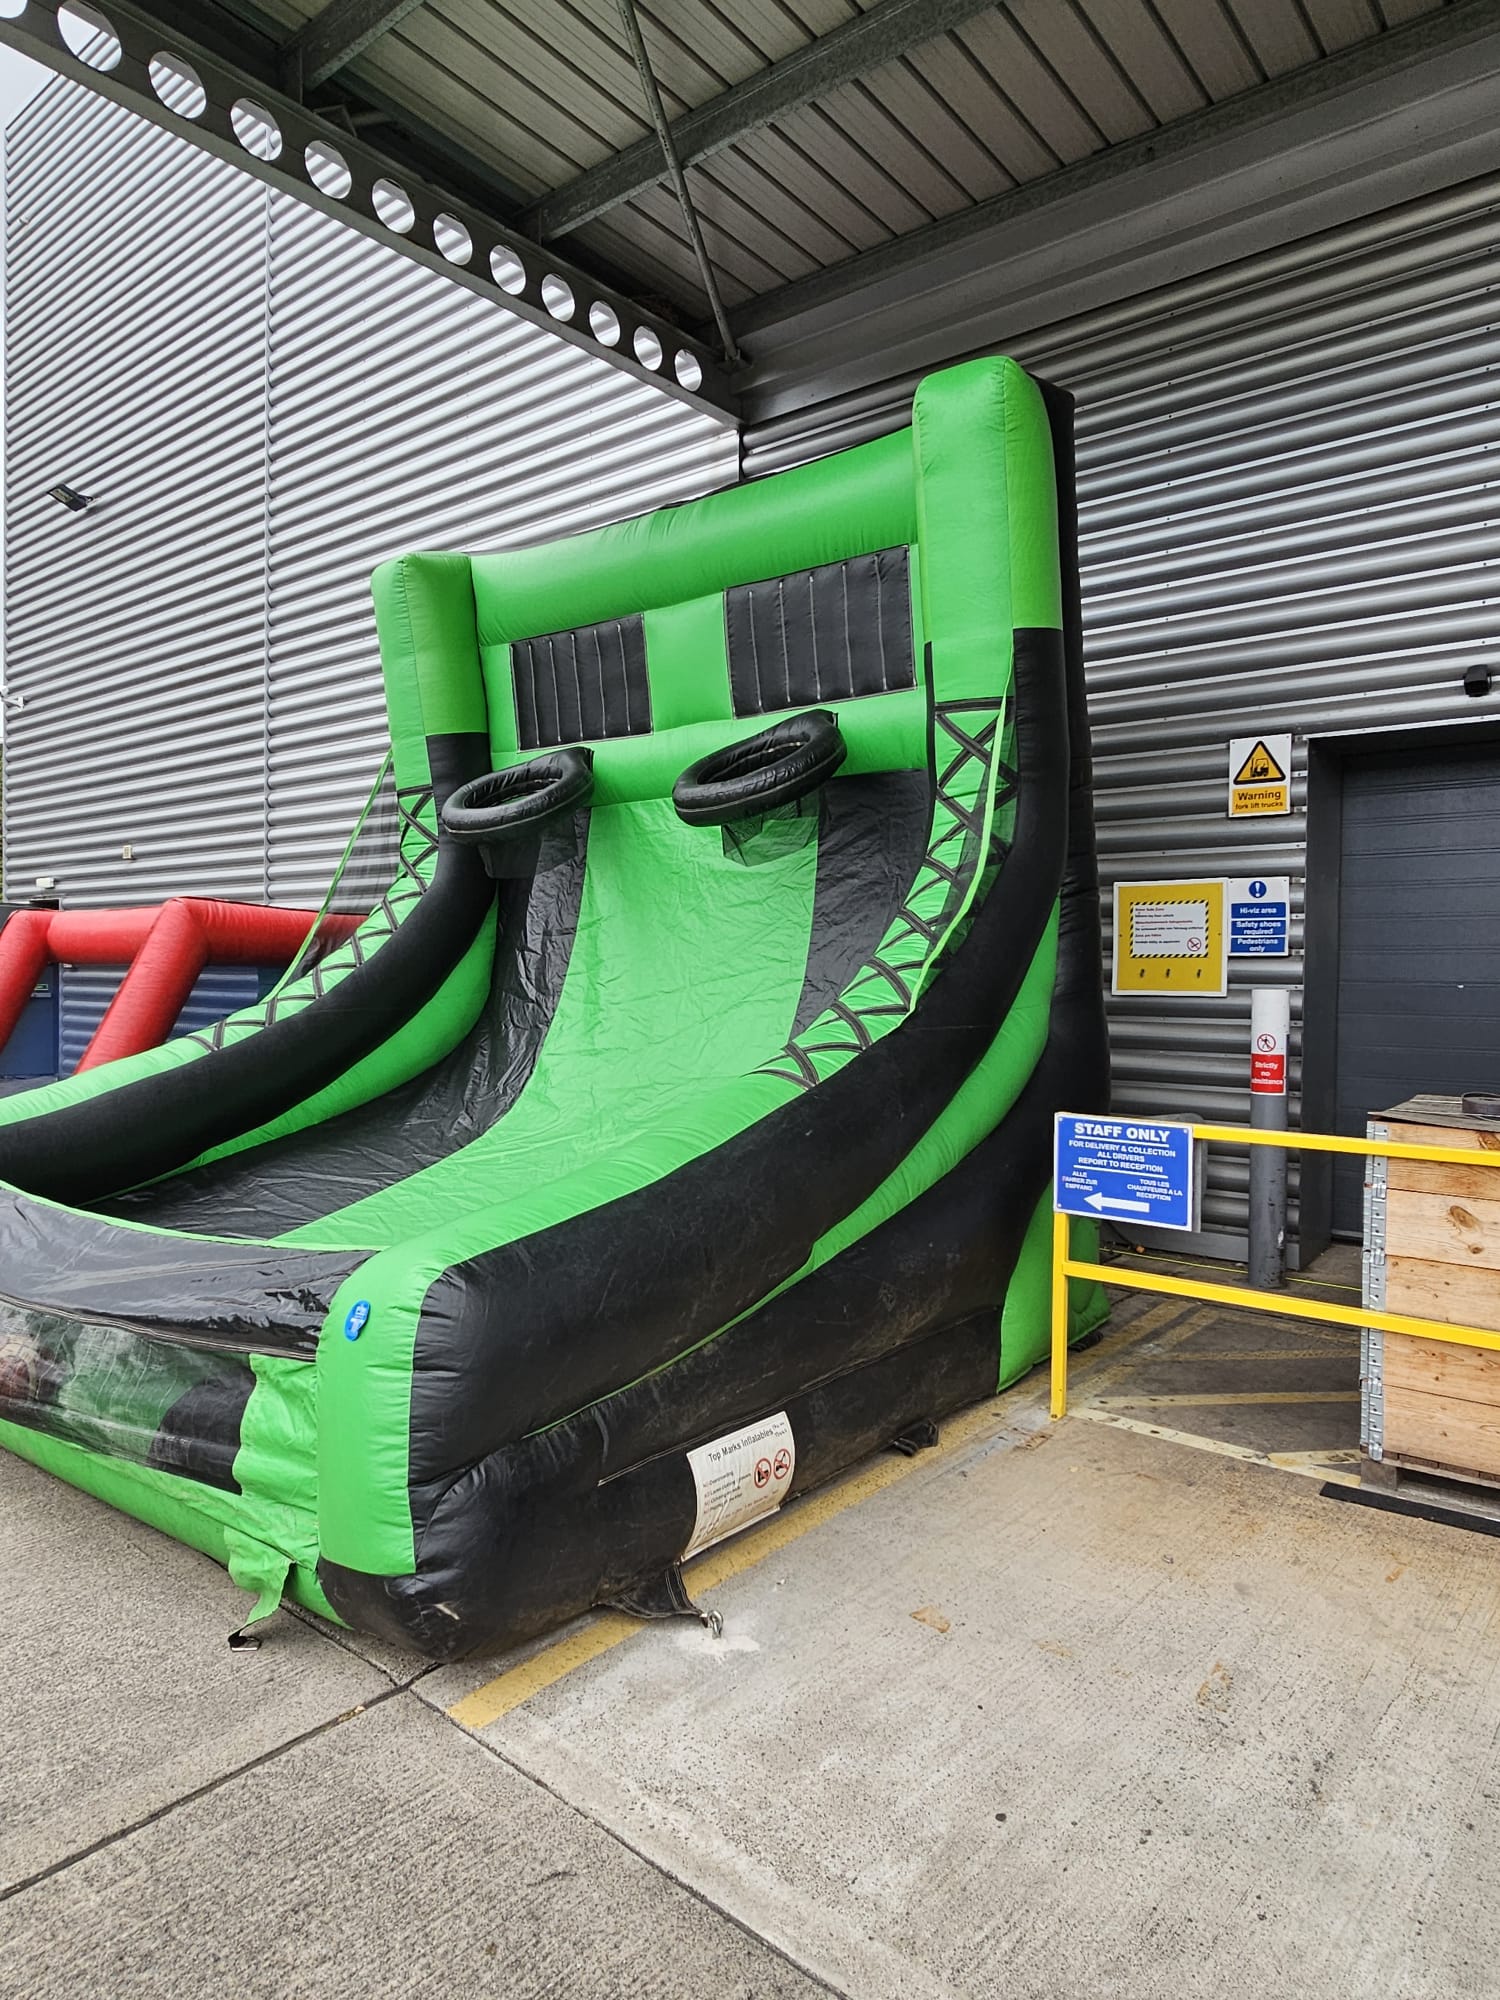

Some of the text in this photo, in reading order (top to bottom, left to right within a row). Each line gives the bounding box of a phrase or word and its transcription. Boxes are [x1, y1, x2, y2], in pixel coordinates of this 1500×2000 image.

[1237, 790, 1281, 800] Warning
[1236, 921, 1258, 929] Safety
[1243, 928, 1274, 936] required
[1249, 945, 1266, 953] only
[1255, 1061, 1278, 1070] Strictly
[1074, 1122, 1170, 1142] STAFF ONLY
[1068, 1140, 1176, 1158] FOR DELIVERY & COLLECTION
[1097, 1151, 1145, 1162] ALL DRIVERS
[1078, 1157, 1163, 1173] REPORT TO RECEPTION
[1065, 1183, 1093, 1191] EMPFANG
[1139, 1178, 1170, 1188] TOUS LES
[1127, 1183, 1168, 1195] CHAUFFEURS
[1136, 1191, 1171, 1201] RECEPTION
[708, 1452, 722, 1463] Top
[721, 1443, 742, 1456] Marks
[741, 1428, 774, 1447] Inflatables
